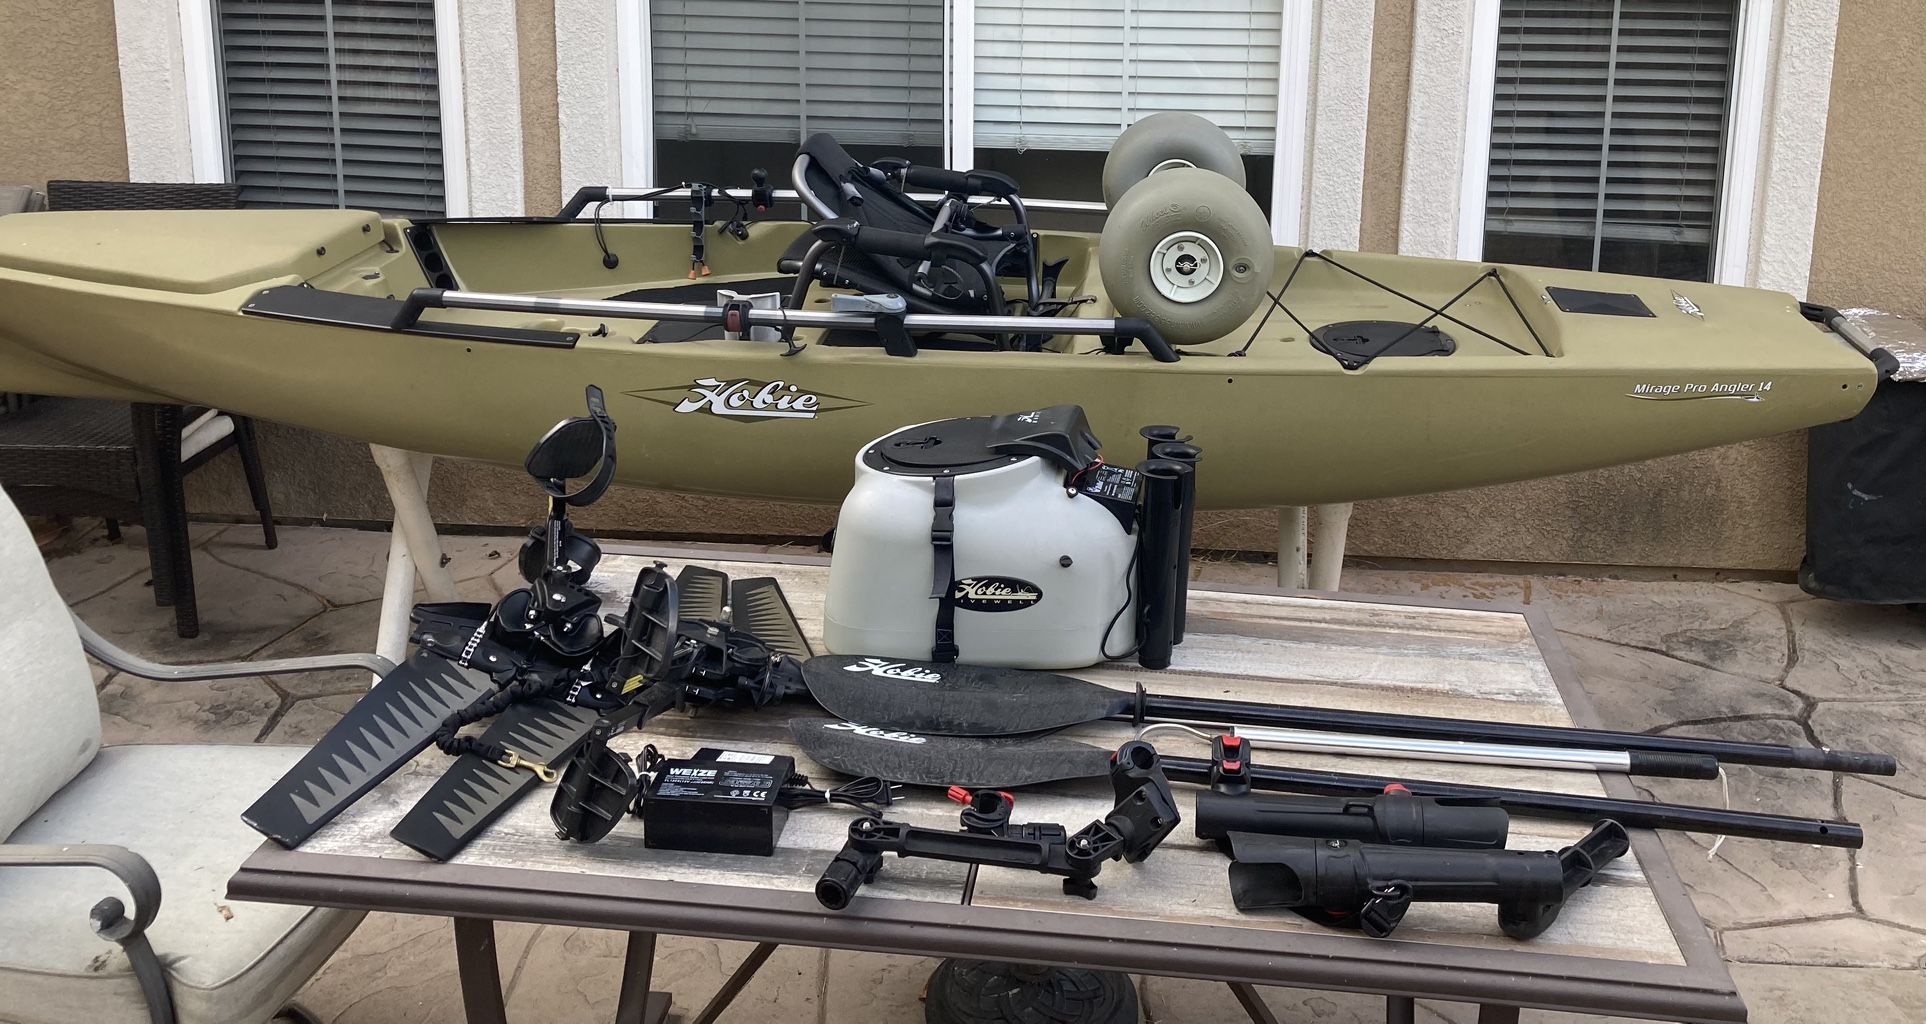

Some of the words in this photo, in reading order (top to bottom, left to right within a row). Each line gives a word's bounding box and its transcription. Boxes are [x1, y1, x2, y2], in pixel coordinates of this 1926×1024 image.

[674, 378, 819, 419] Hobie
[1634, 383, 1681, 395] Mirage
[1683, 383, 1707, 393] Pro
[1710, 382, 1755, 394] Angler
[1757, 381, 1773, 392] 14
[954, 579, 1038, 600] Hobie
[843, 658, 942, 683] Hobie
[822, 721, 927, 744] Hobie
